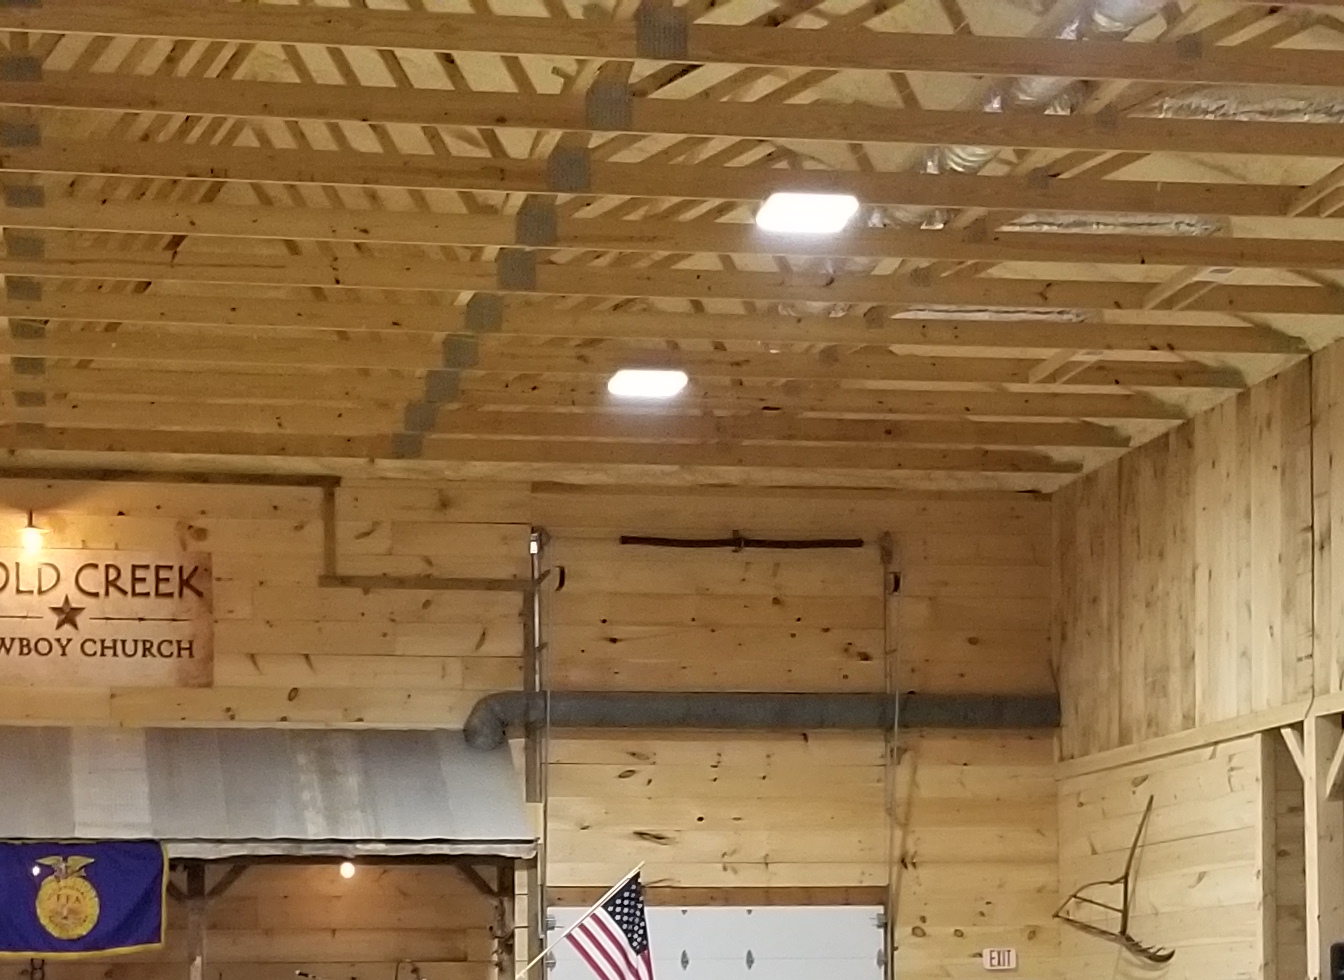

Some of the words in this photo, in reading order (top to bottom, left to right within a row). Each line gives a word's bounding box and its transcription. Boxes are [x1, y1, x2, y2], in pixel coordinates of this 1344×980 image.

[75, 563, 204, 599] CREEK
[80, 638, 195, 659] CHURCH
[989, 950, 1011, 967] EXIT
